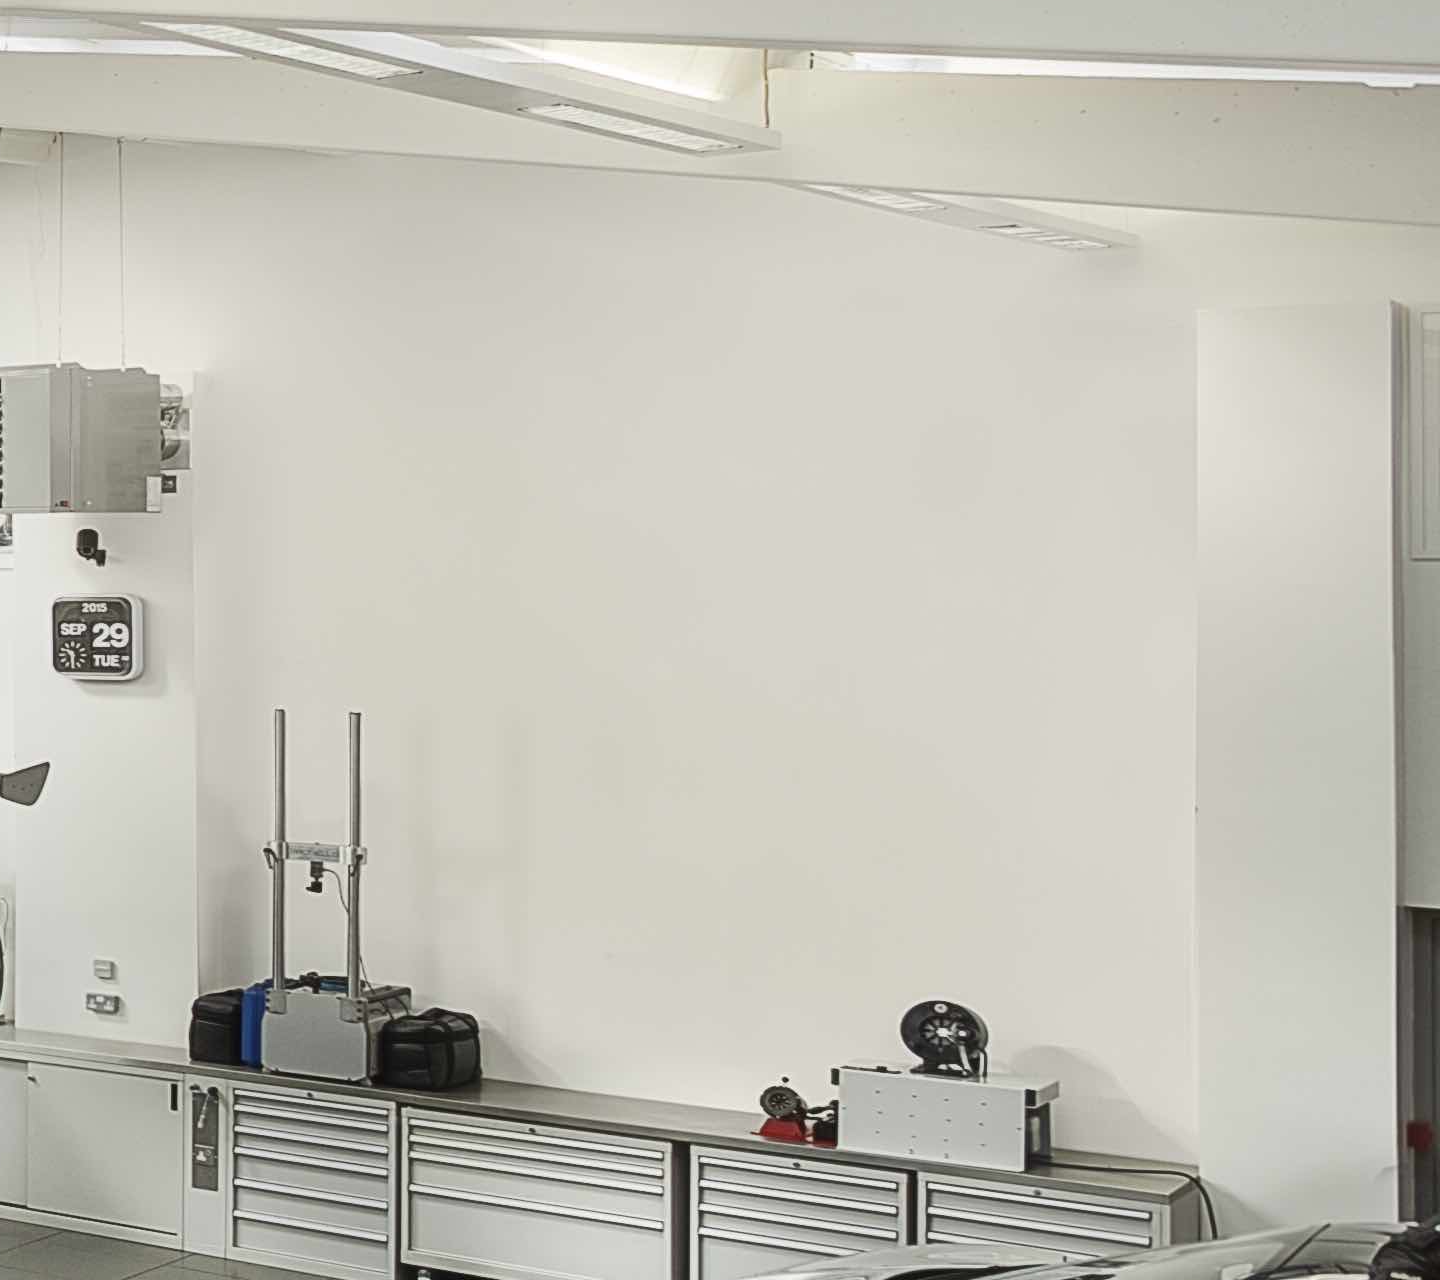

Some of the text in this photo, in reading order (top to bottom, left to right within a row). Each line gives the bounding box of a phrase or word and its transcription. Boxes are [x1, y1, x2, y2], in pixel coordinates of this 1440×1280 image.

[81, 603, 108, 613] 2015
[60, 622, 129, 648] SEP 29
[93, 655, 121, 667] TUE
